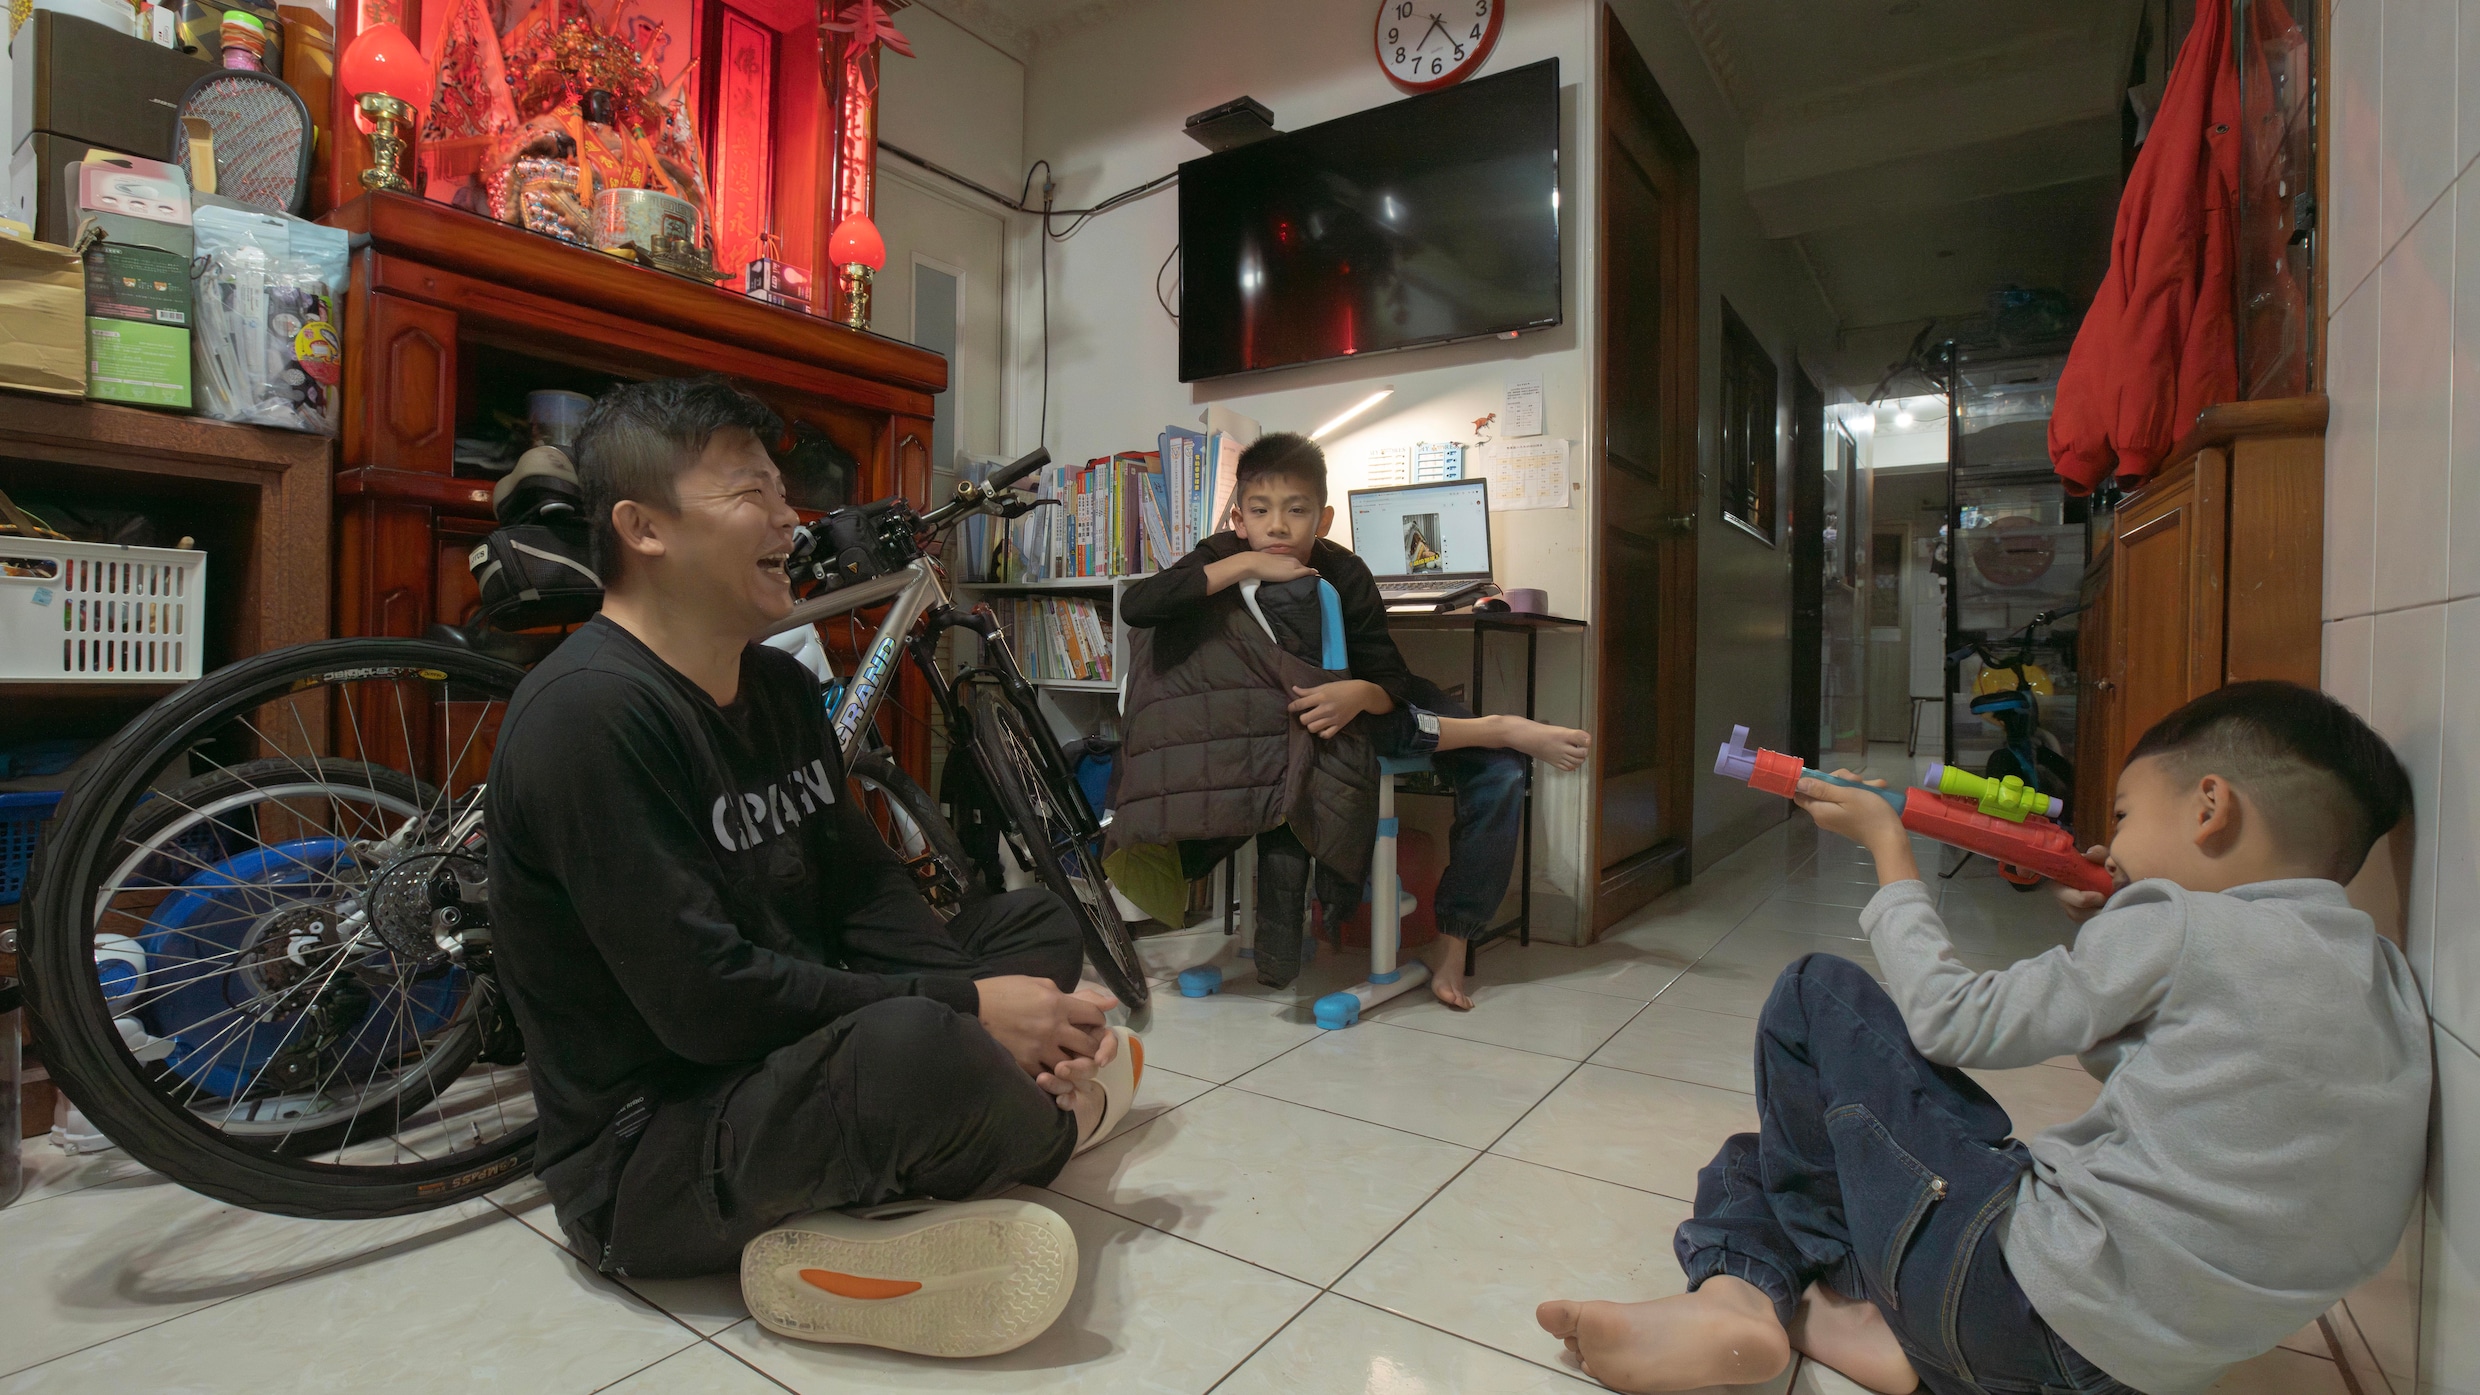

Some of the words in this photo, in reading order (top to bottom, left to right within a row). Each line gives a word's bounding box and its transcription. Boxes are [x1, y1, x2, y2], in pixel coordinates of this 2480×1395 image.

[1395, 1, 1413, 20] 10
[1388, 27, 1399, 45] 9
[1469, 22, 1481, 40] 4
[1395, 46, 1406, 64] 8
[1453, 43, 1465, 62] 5
[1411, 56, 1422, 75] 7
[1431, 57, 1442, 75] 6
[835, 637, 897, 754] GRAND
